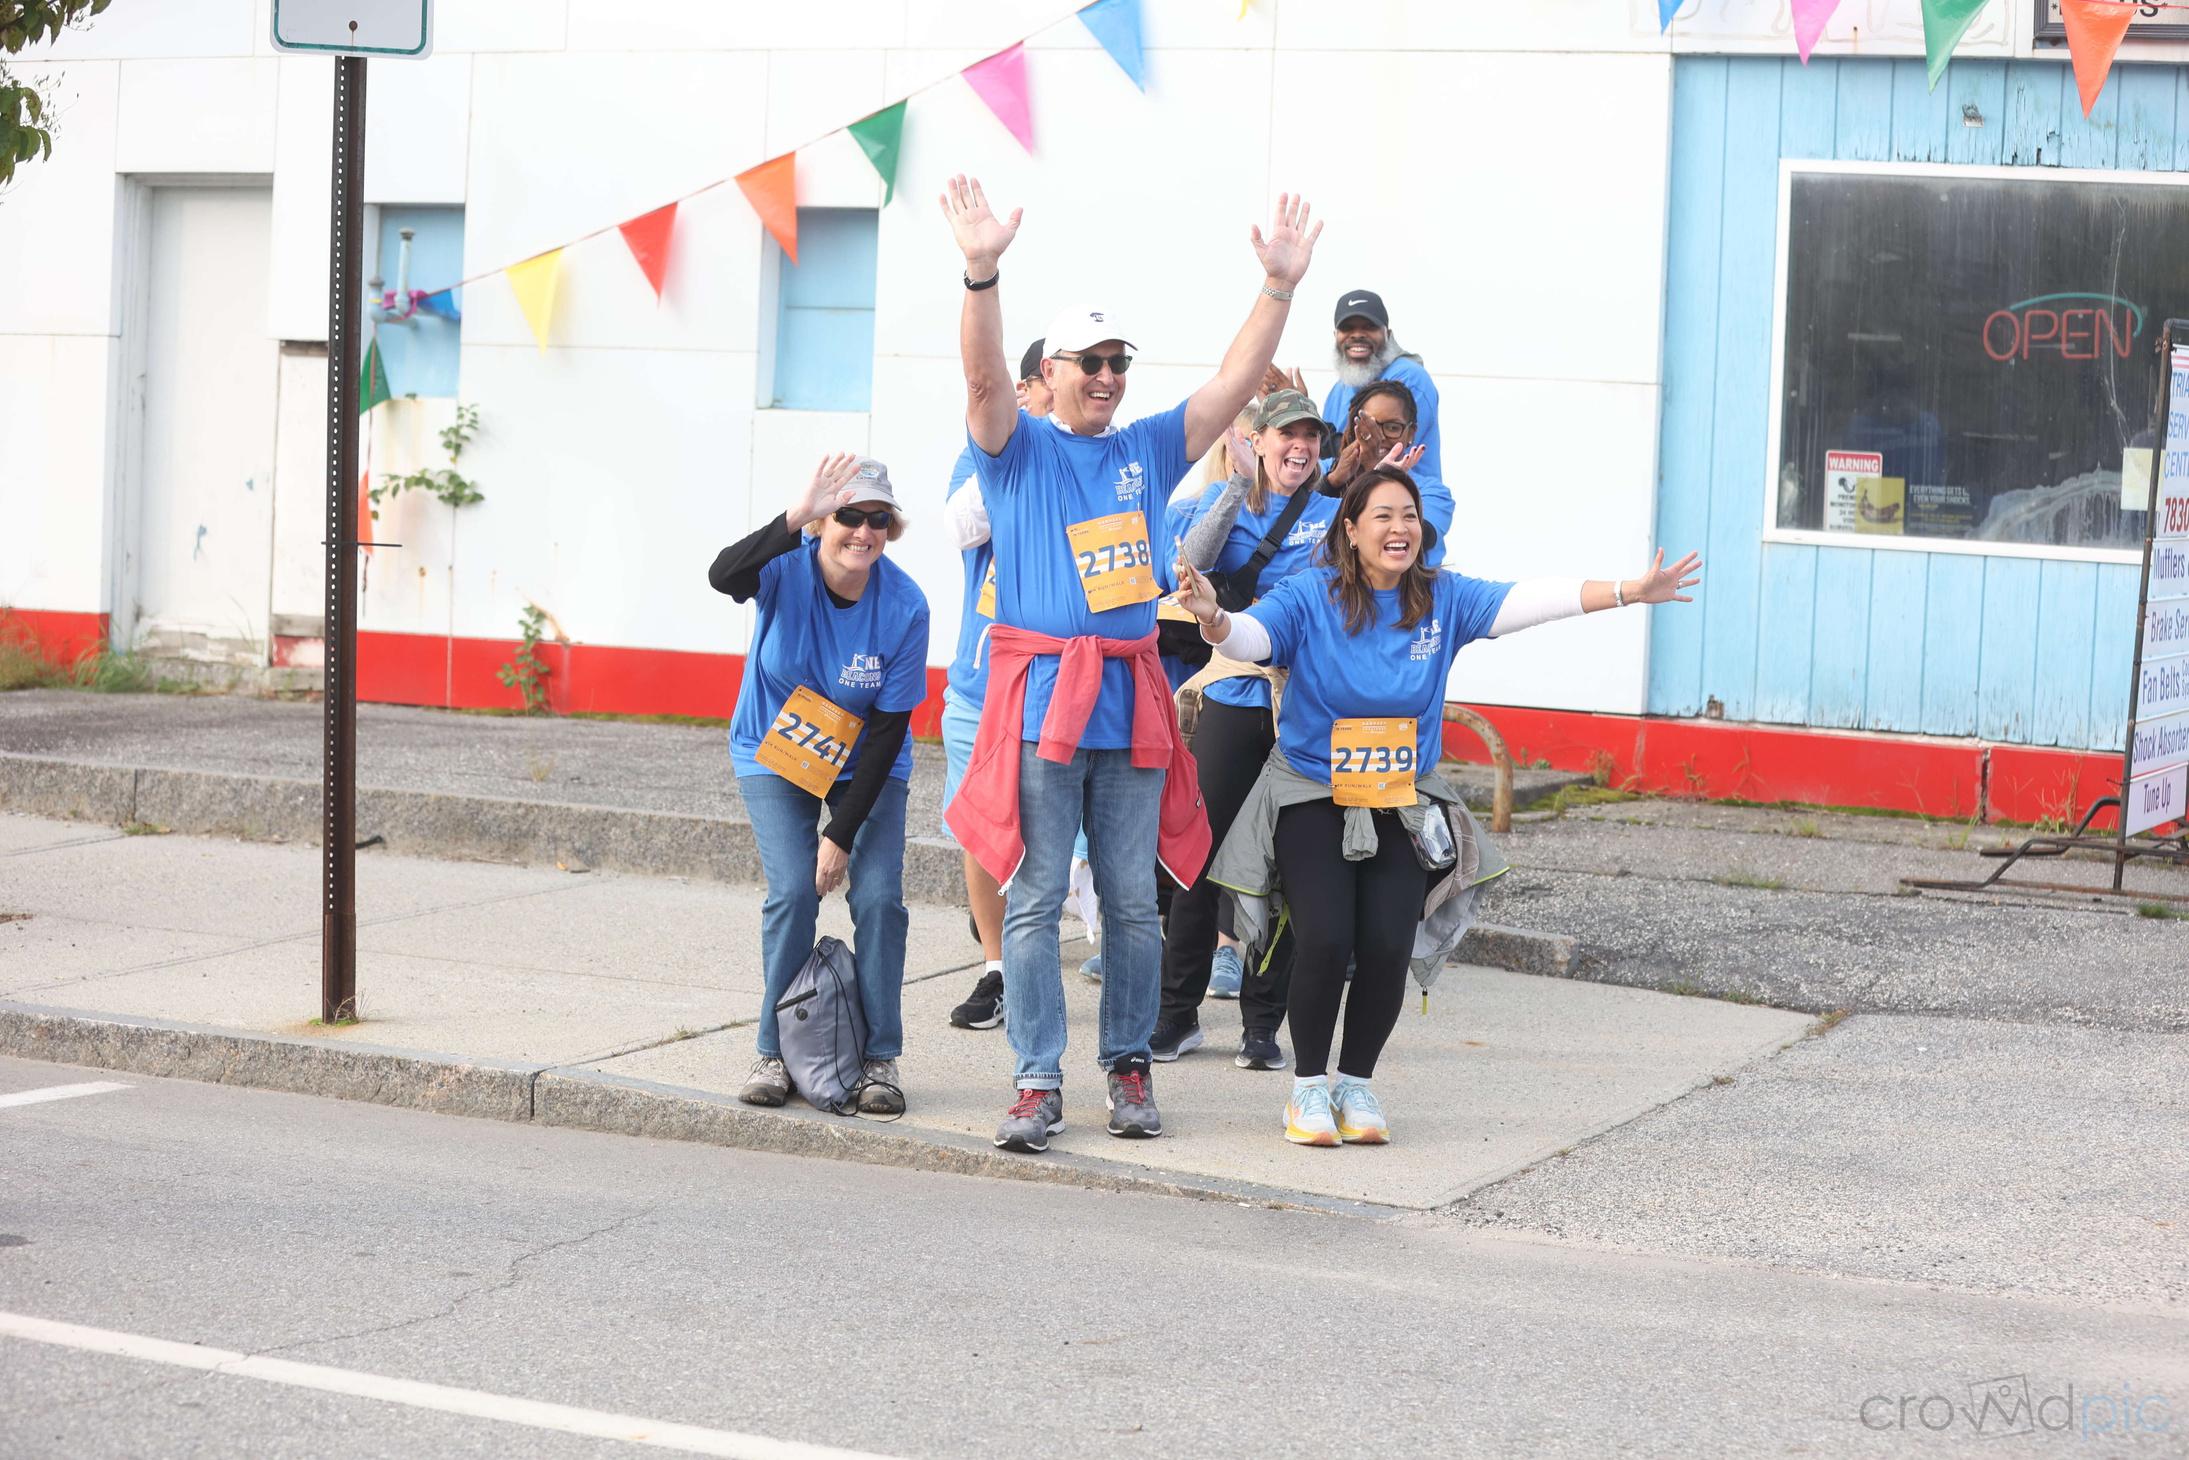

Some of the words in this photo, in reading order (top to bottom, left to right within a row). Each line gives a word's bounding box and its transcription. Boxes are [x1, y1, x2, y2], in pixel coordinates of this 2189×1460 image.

[1983, 309, 2132, 361] OPEN
[1828, 457, 1879, 472] WARNING
[1117, 493, 1134, 502] ONE
[1078, 539, 1150, 578] 2738
[2153, 546, 2185, 580] Mufflers
[2150, 610, 2173, 643] Brake
[838, 678, 856, 688] ONE
[859, 681, 882, 689] TEAM
[2142, 669, 2157, 704] Fan
[2160, 666, 2180, 701] Belts
[777, 712, 847, 766] 2741
[2133, 731, 2156, 764] Shock
[1335, 746, 1413, 773] 2739
[2143, 781, 2160, 814] Tune
[2161, 778, 2171, 814] Up
